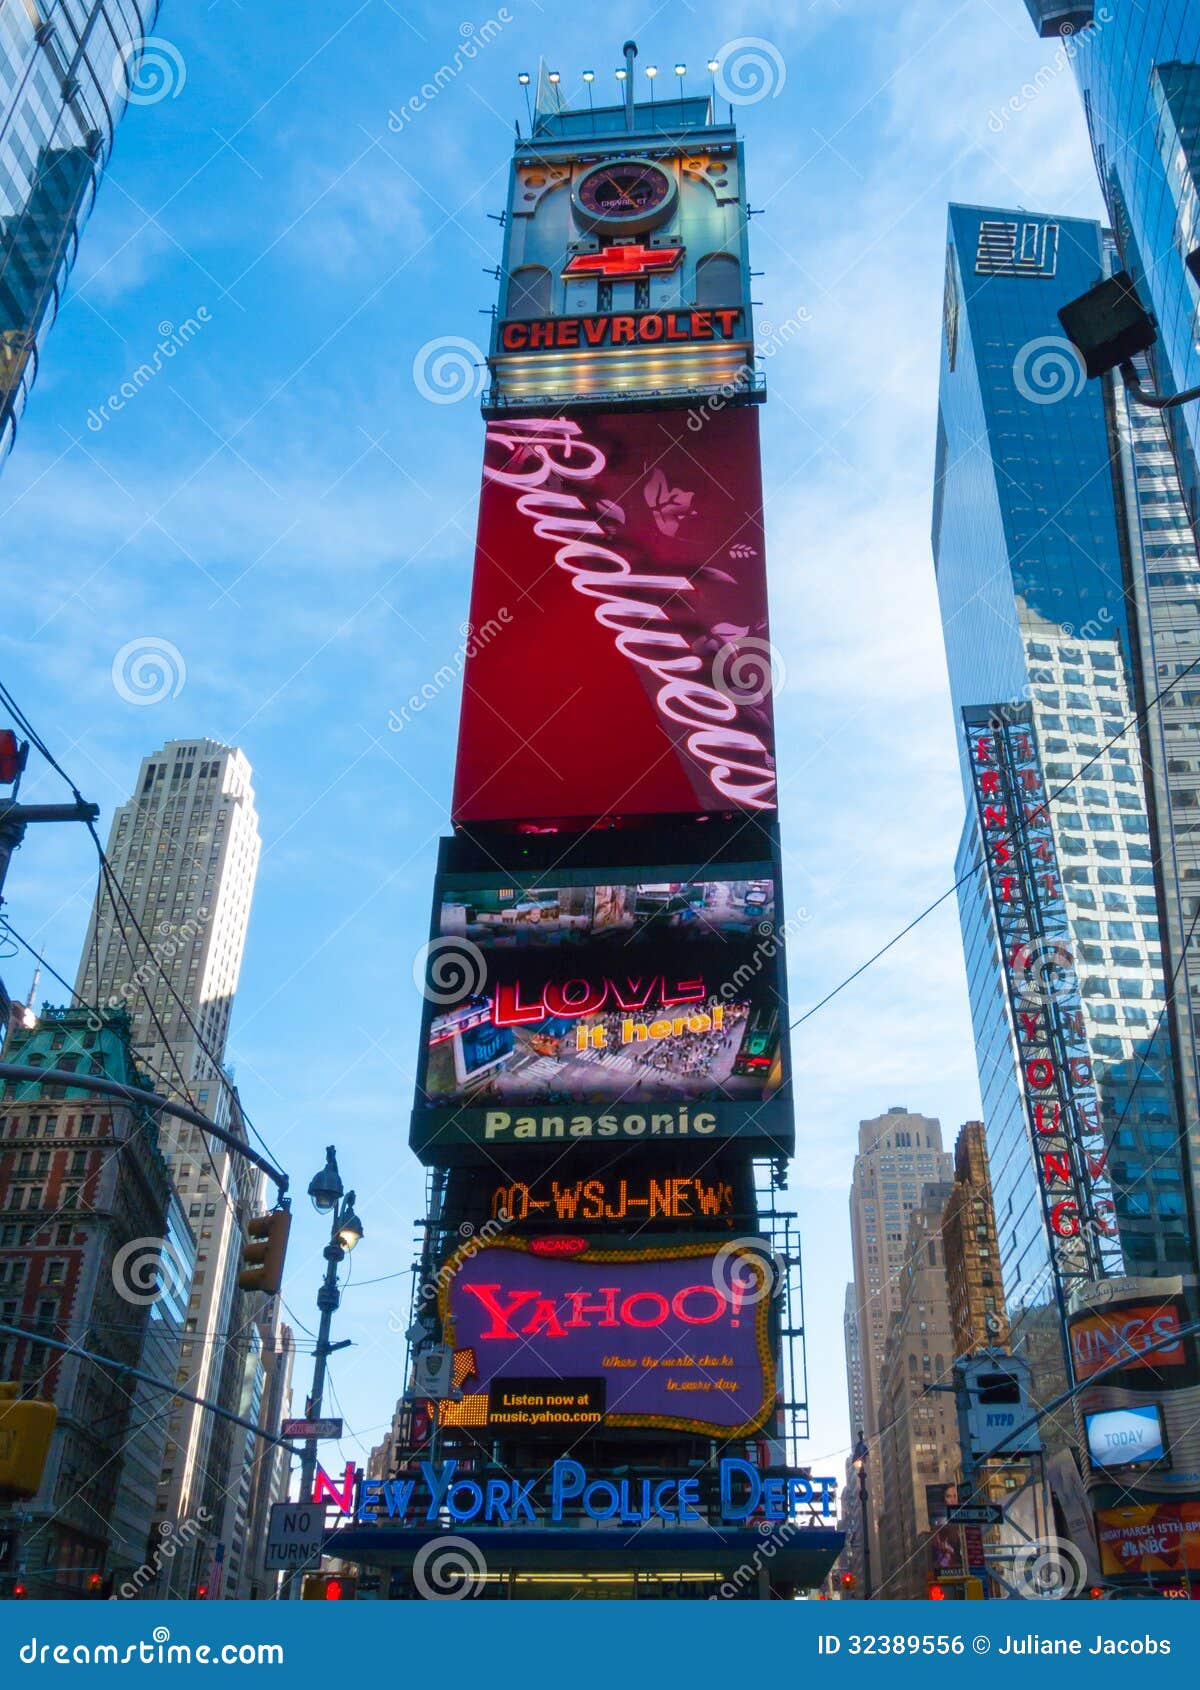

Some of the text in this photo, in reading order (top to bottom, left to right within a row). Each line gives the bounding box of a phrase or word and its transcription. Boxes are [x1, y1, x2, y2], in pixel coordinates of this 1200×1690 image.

[601, 198, 646, 207] CHEVROET
[502, 309, 739, 349] CHEVROLET
[977, 737, 1015, 901] ERNST
[576, 1005, 724, 1051] it here!
[484, 1106, 717, 1139] Panasonic
[1020, 1012, 1079, 1237] YOUNG
[531, 1239, 585, 1251] VACANCY
[462, 1279, 747, 1340] YAHOO!
[1072, 1316, 1180, 1367] KINGS
[503, 1394, 589, 1406] Listen now at
[490, 1411, 601, 1425] music.yahoo.com
[986, 1413, 1015, 1427] NYPD
[1104, 1429, 1144, 1447] TODAY
[312, 1457, 837, 1521] NEW YORK POLICE DEPT
[284, 1512, 311, 1533] NO
[1122, 1524, 1155, 1536] MARCH
[270, 1542, 319, 1560] TURNS
[1139, 1537, 1170, 1555] NBC
